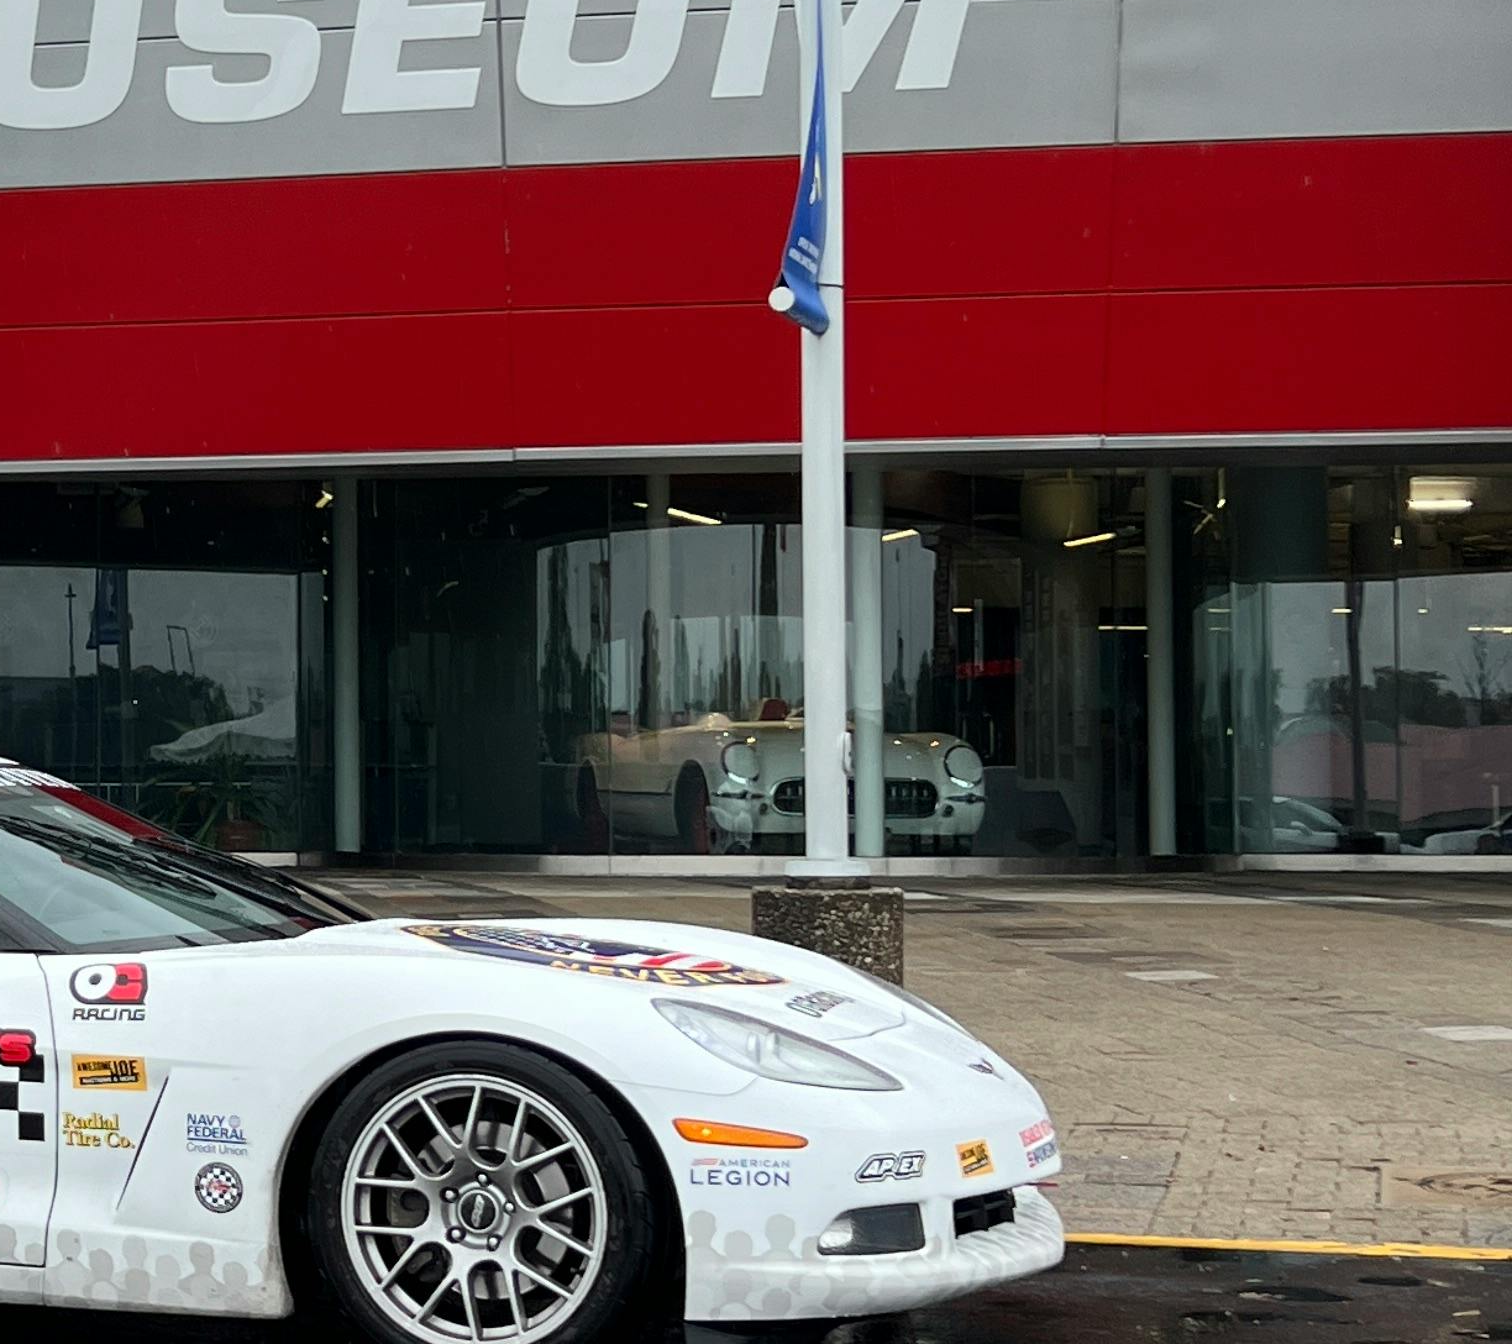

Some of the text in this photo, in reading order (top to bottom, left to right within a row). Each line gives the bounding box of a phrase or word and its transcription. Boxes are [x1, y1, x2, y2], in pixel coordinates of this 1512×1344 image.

[72, 1007, 146, 1021] RACING
[110, 1059, 138, 1076] JOE
[62, 1111, 120, 1131] Radial
[186, 1113, 225, 1127] NAVY
[63, 1130, 136, 1149] Tire Co.
[186, 1126, 247, 1140] FEDERAL
[186, 1142, 248, 1156] Credit Union
[718, 1158, 790, 1168] AMERICAN
[855, 1150, 927, 1183] APEX
[690, 1169, 790, 1186] LEGION
